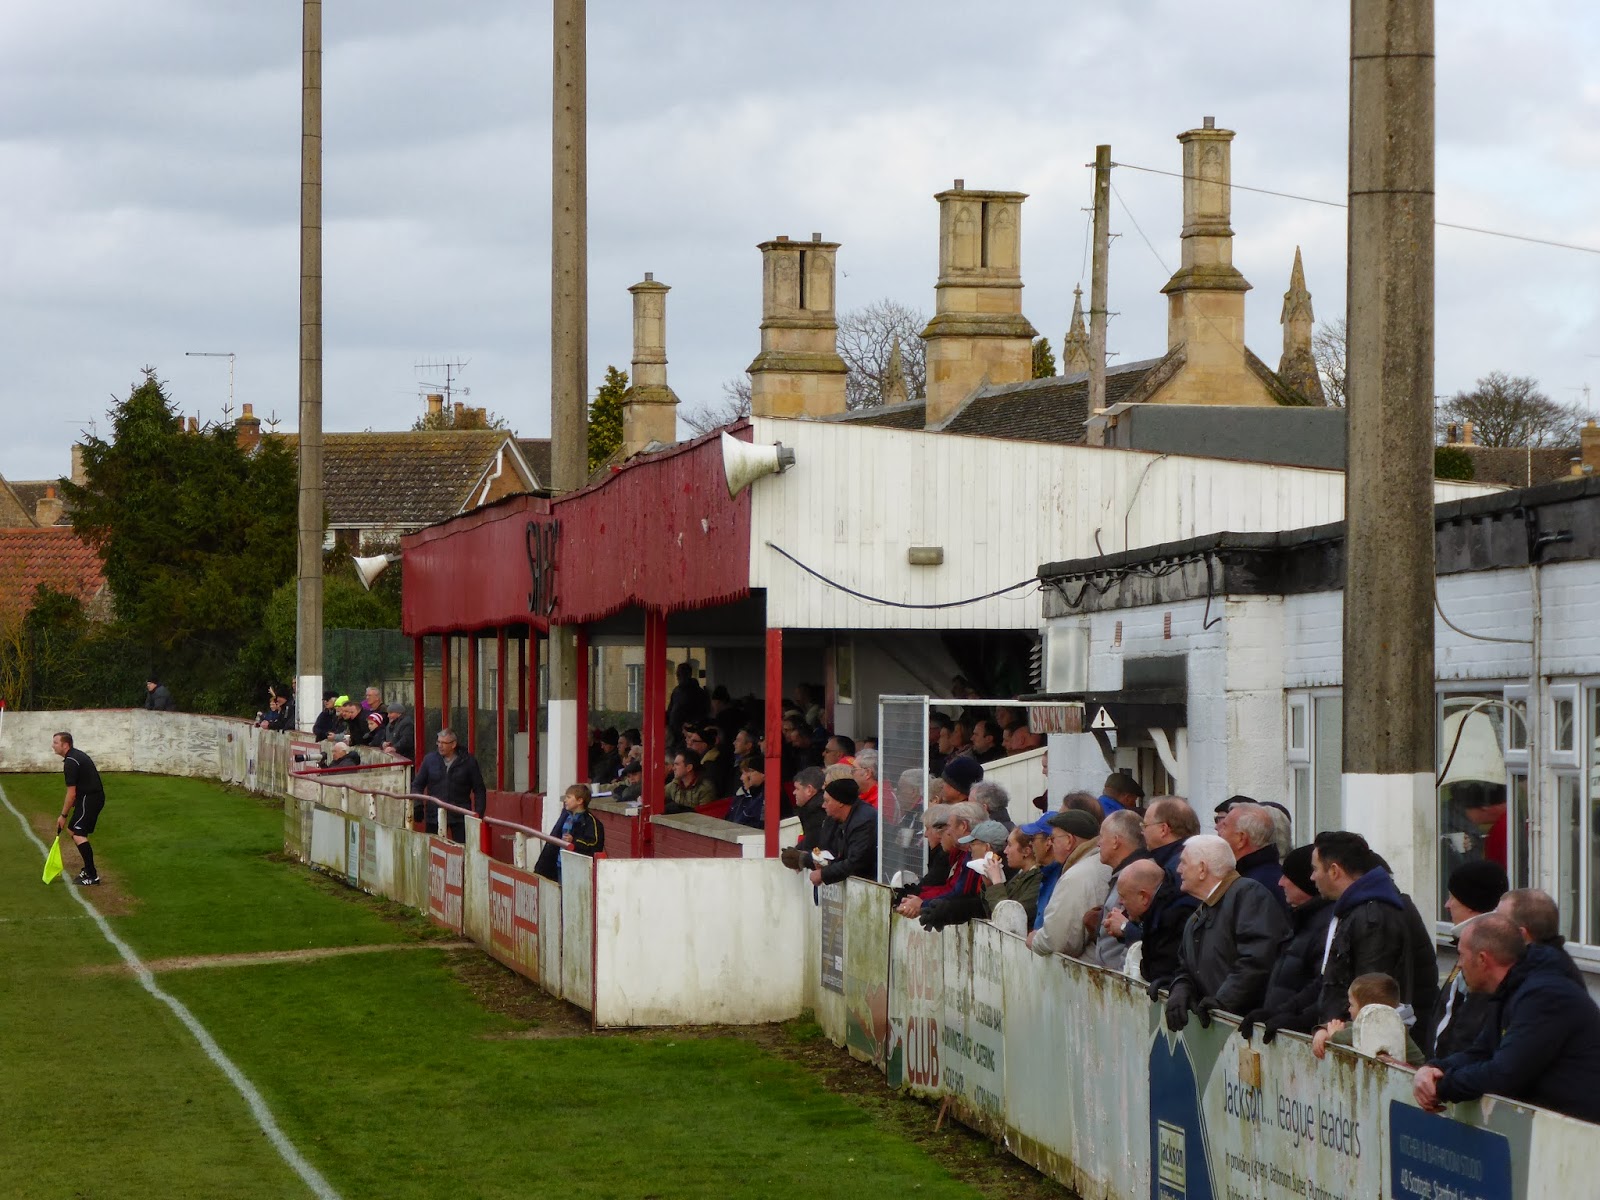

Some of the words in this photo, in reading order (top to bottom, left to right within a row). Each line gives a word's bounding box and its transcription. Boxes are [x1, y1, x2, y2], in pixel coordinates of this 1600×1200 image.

[1032, 707, 1060, 732] SNACK
[907, 1015, 939, 1088] CLUB
[1276, 1078, 1314, 1148] league
[1318, 1094, 1361, 1159] leaders
[1161, 1132, 1184, 1169] jackson
[1231, 1152, 1250, 1181] providing
[1270, 1162, 1291, 1190] Bathroom
